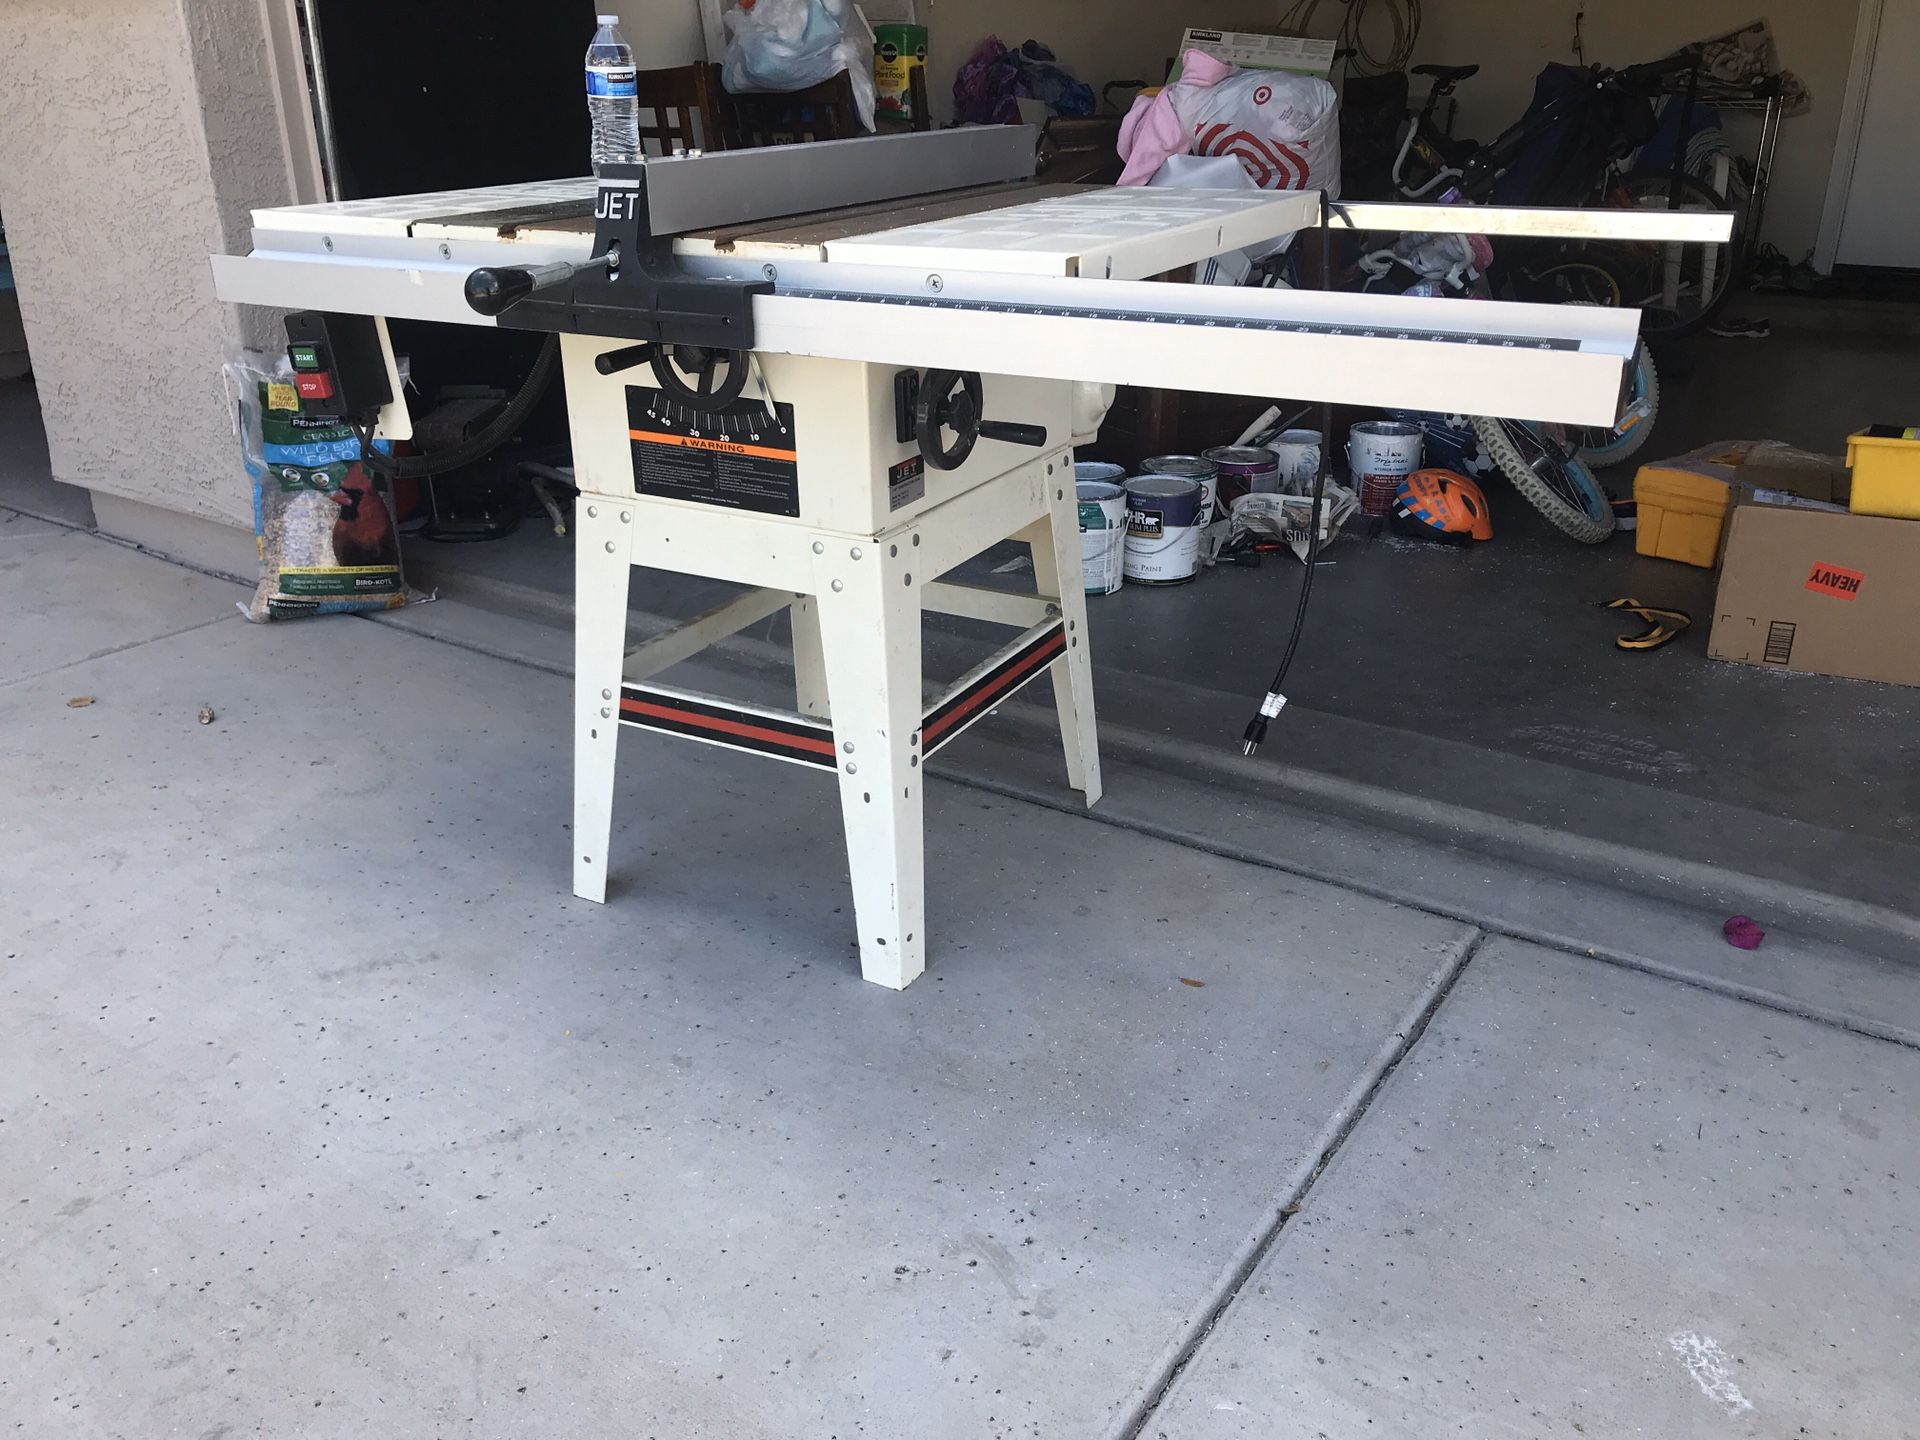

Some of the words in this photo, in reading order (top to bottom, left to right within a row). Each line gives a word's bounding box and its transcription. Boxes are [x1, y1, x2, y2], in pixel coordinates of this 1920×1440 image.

[1191, 31, 1222, 39] KIRKLAND
[594, 192, 639, 219] JET
[302, 383, 316, 391] STOP
[646, 409, 656, 419] 45
[661, 417, 671, 426] 40
[689, 429, 700, 437] 30
[720, 434, 730, 442] 20
[780, 426, 787, 434] 0
[280, 444, 329, 456] WILD
[333, 438, 361, 452] BIR
[690, 439, 745, 453] WARNING
[896, 463, 917, 479] JET
[1141, 563, 1163, 573] PAINT
[1809, 569, 1861, 593] HEAVY
